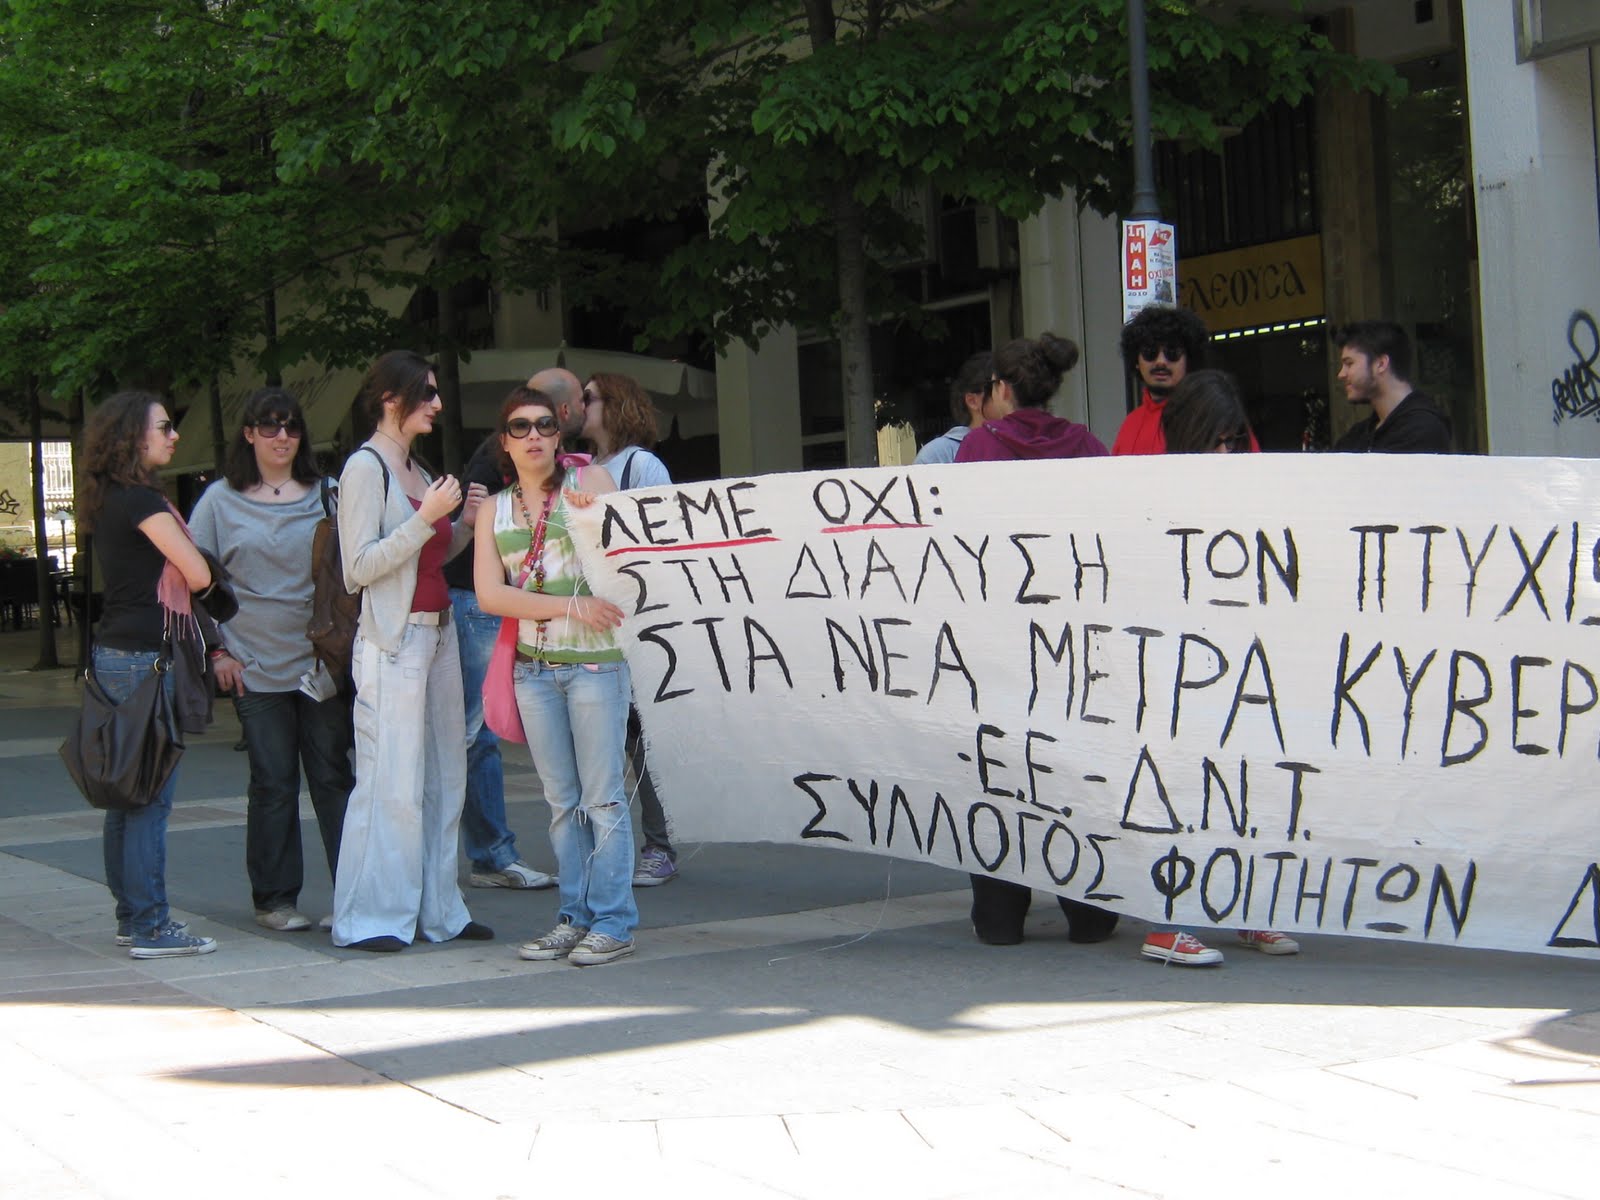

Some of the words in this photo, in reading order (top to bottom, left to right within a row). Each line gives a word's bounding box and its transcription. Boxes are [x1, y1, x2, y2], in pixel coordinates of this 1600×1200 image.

[601, 481, 772, 550] ΛΕΜΕ
[813, 474, 943, 530] ΟΧΙ:
[617, 553, 755, 616] ΣΤΗ
[785, 533, 1109, 605] ΔΙΑΛΥΣΗ
[1165, 526, 1300, 607] ΤΩΝ
[1349, 521, 1600, 626] ΠΤΥΧΙ
[637, 615, 793, 703] ΣΤΑ
[825, 615, 979, 714] ΝΕΑ
[1028, 618, 1286, 755] ΜΕΤΡΑ
[1330, 632, 1600, 768] ΚΥΒΕΡ
[793, 771, 1125, 902] ΣΥΛΛΟΓΟΣ
[1150, 844, 1477, 941] ΦΟΙΤΗΤΩΝ
